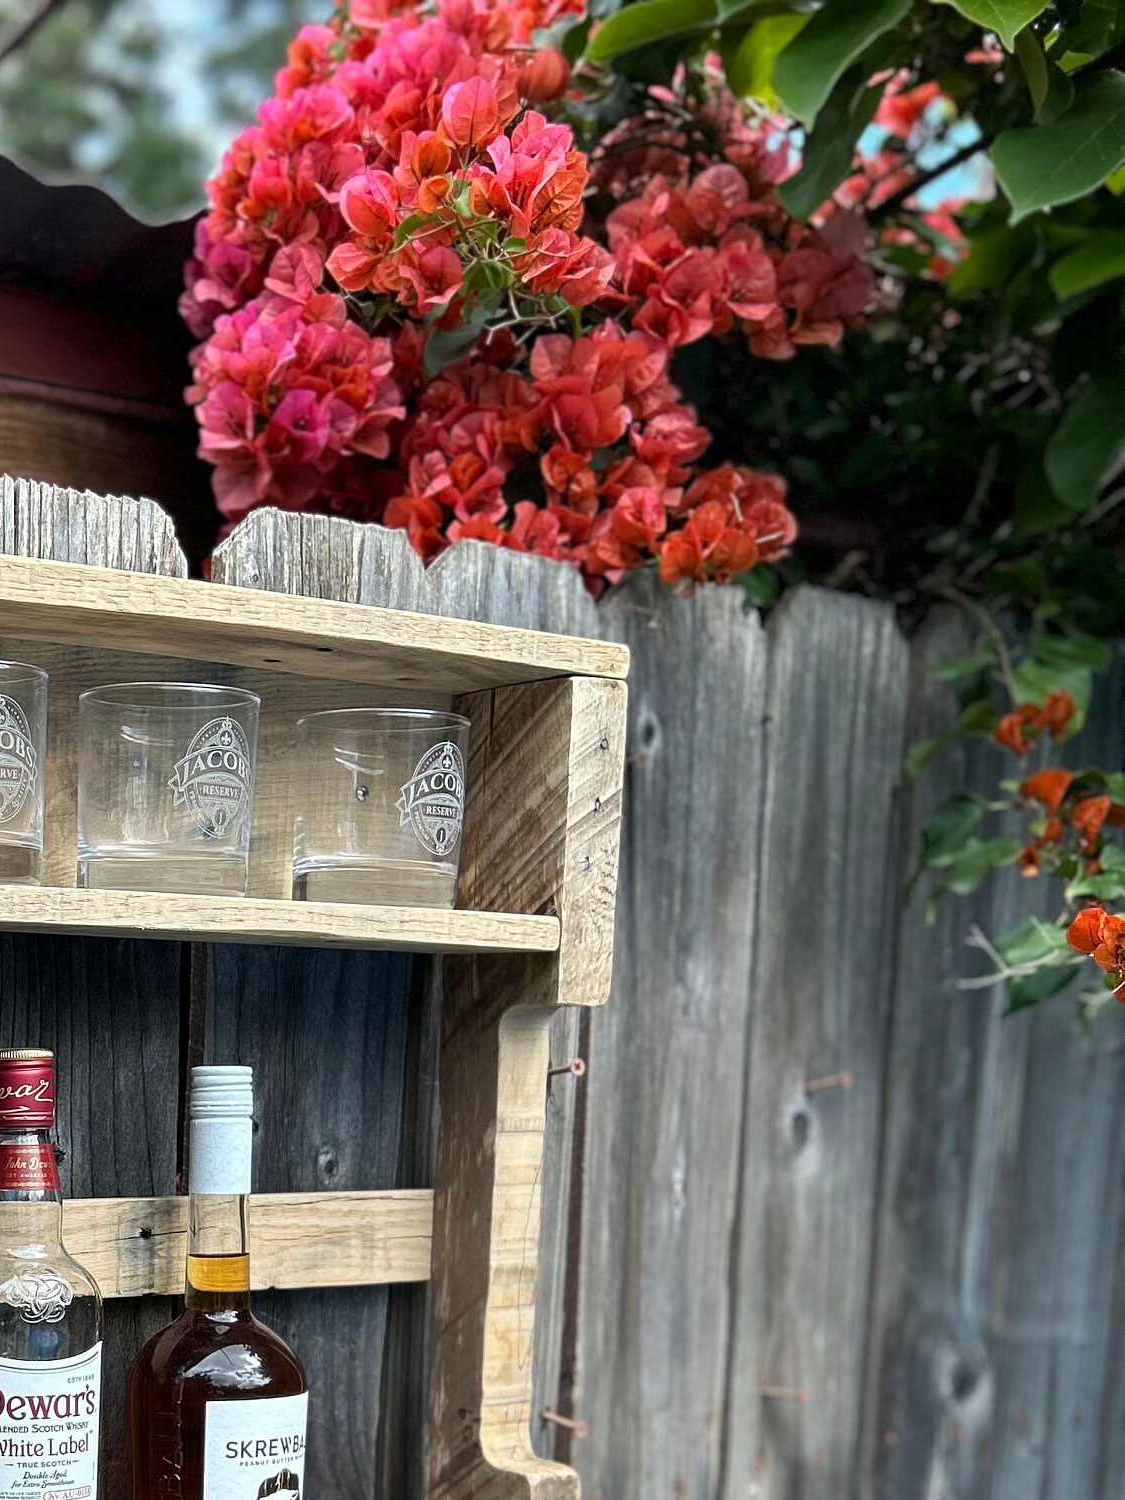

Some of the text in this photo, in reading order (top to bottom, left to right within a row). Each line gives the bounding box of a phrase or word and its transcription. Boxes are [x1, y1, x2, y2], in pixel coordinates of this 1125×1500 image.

[202, 785, 239, 799] RESERVE
[426, 805, 456, 817] RESERVE
[41, 1459, 72, 1467] SCOTCH
[271, 1456, 294, 1465] BUTTER
[22, 1471, 49, 1480] Double
[10, 1480, 22, 1489] for
[22, 1480, 41, 1488] Extra
